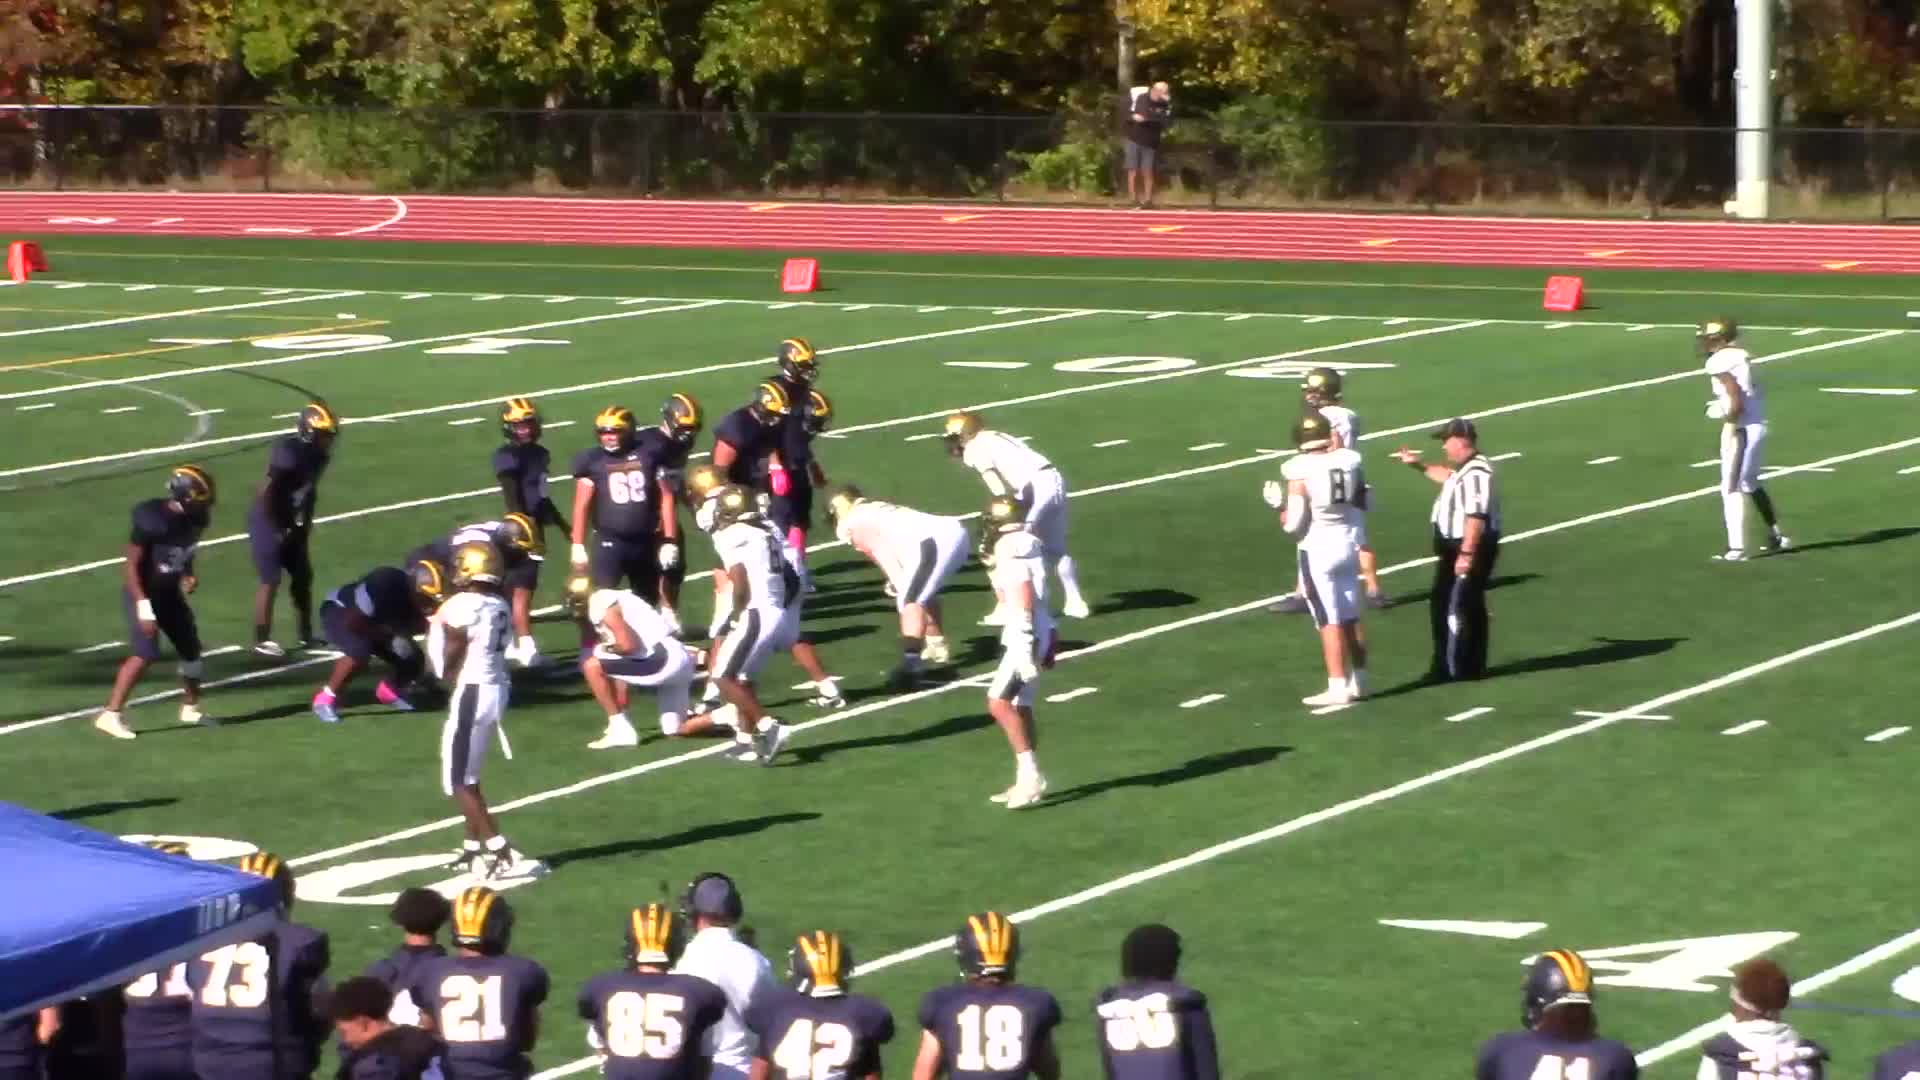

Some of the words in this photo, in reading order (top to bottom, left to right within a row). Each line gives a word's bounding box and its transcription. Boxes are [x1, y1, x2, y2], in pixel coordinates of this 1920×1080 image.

[200, 942, 270, 1007] 73
[439, 975, 508, 1042] 21
[606, 990, 688, 1059] 85
[956, 1003, 1025, 1071] 18
[772, 1018, 854, 1080] 42
